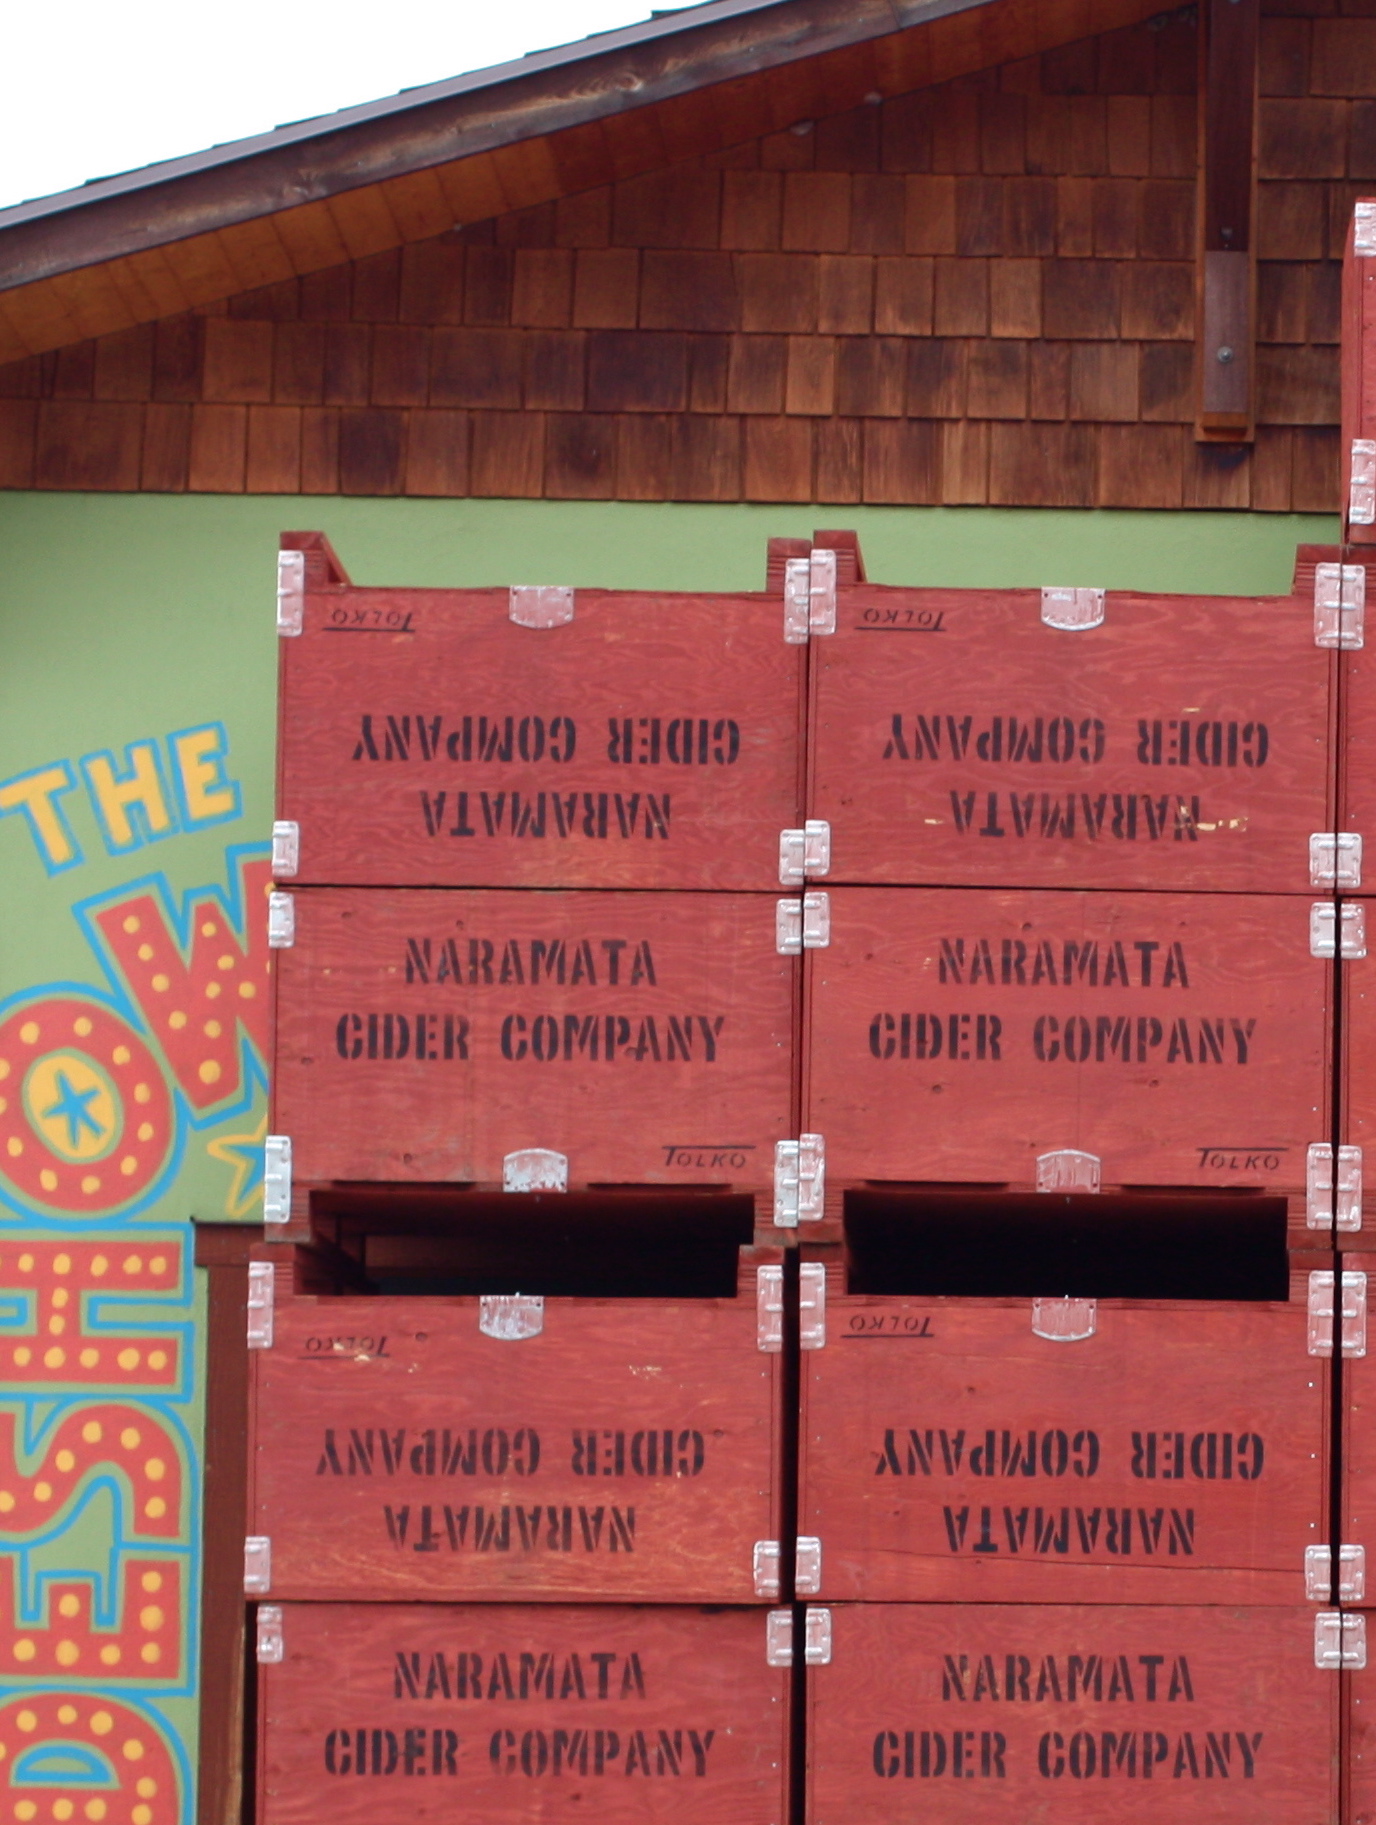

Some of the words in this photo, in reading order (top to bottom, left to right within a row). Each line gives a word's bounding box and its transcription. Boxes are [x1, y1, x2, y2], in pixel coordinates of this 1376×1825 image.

[322, 610, 415, 633] TOLKO
[855, 609, 945, 632] TOLKO
[353, 715, 576, 762] COMPANY
[608, 718, 739, 764] CIDER
[883, 714, 1104, 762] COMPANY
[1138, 721, 1268, 766] CIDER
[0, 722, 243, 878] THE
[421, 792, 670, 839] NARAMATA
[950, 791, 1199, 841] NARAMATA
[406, 939, 656, 985] NARAMATA
[939, 939, 1188, 987] NARAMATA
[336, 1014, 468, 1059] CIDER
[501, 1015, 723, 1061] COMPANY
[870, 1014, 1001, 1059] CIDER
[1034, 1017, 1255, 1064] COMPANY
[662, 1145, 756, 1168] TOLKO
[1197, 1147, 1289, 1170] TOLKO
[841, 1316, 934, 1339] TOLKO
[317, 1429, 540, 1475] COMPANY
[572, 1430, 704, 1475] CIDER
[876, 1430, 1099, 1476] COMPANY
[1132, 1432, 1263, 1479] CIDER
[384, 1506, 635, 1552] NARAMATA
[944, 1507, 1194, 1555] NARAMATA
[395, 1653, 644, 1699] NARAMATA
[943, 1655, 1193, 1701] NARAMATA
[325, 1729, 457, 1775] CIDER
[490, 1730, 714, 1776] COMPANY
[873, 1732, 1006, 1777] CIDER
[1038, 1732, 1262, 1778] COMPANY
